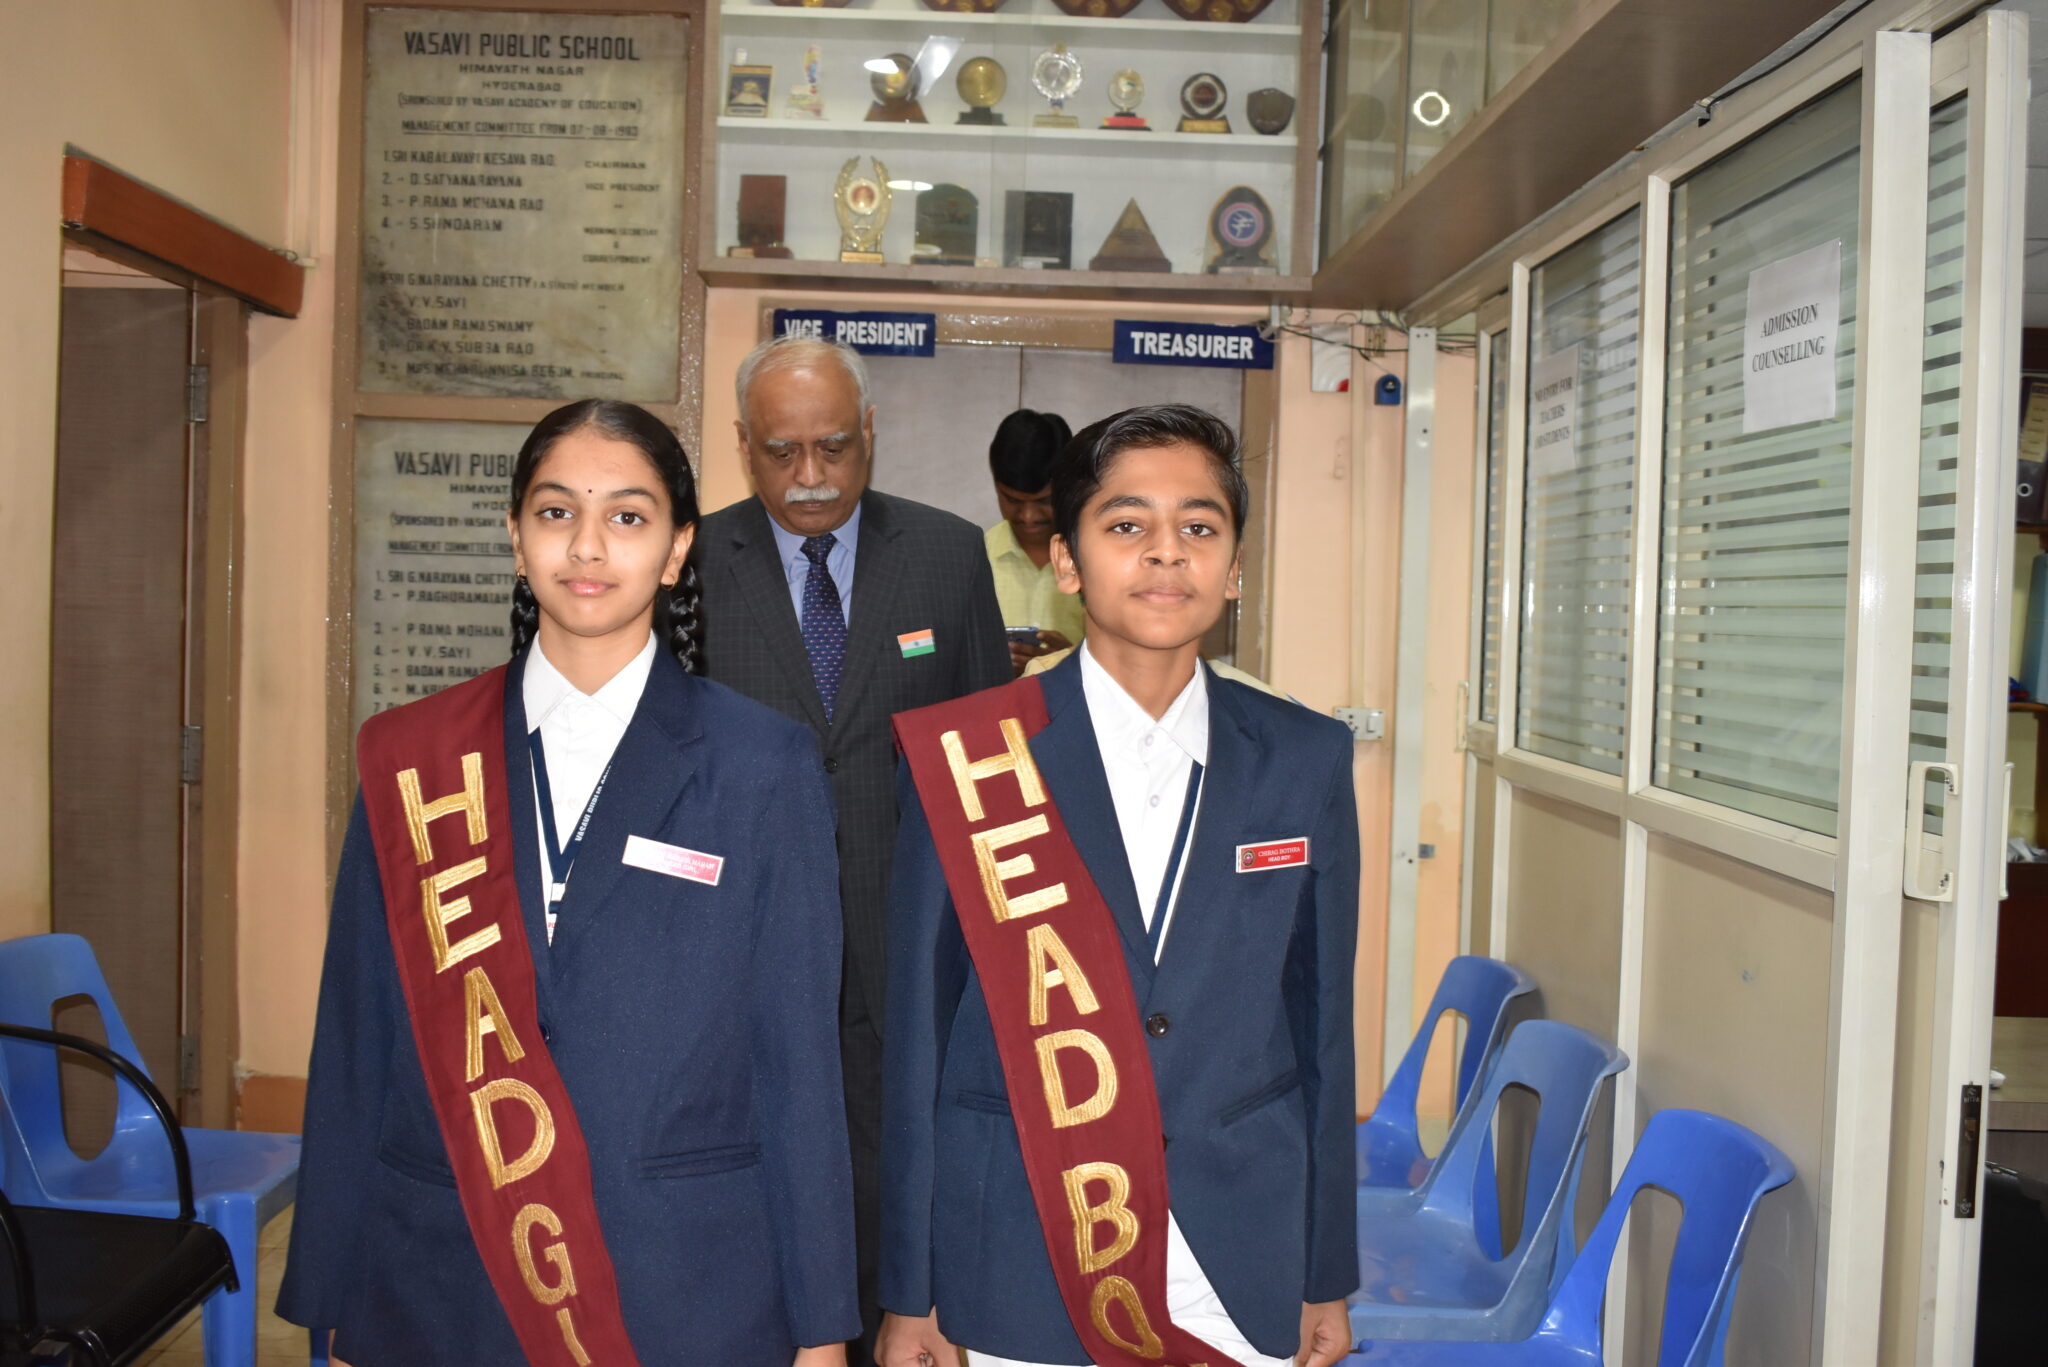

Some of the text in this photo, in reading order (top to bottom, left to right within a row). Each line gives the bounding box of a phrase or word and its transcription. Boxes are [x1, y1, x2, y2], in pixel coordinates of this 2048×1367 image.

[404, 31, 640, 61] VASAVI PUBLIC SCHOOL
[459, 63, 585, 76] HIMAYATH NAGAR
[784, 318, 927, 346] VICE PRESIDENT
[1760, 303, 1820, 338] ADMISSION
[1131, 331, 1254, 360] TREASURER
[1752, 336, 1826, 372] COUNSELLING
[394, 450, 461, 476] VASAVI
[450, 483, 510, 494] HIMAYAT
[575, 814, 591, 841] VASAVI
[940, 717, 1118, 1129] HEAD
[396, 750, 556, 1191] HEAD
[1062, 1160, 1207, 1367] BO
